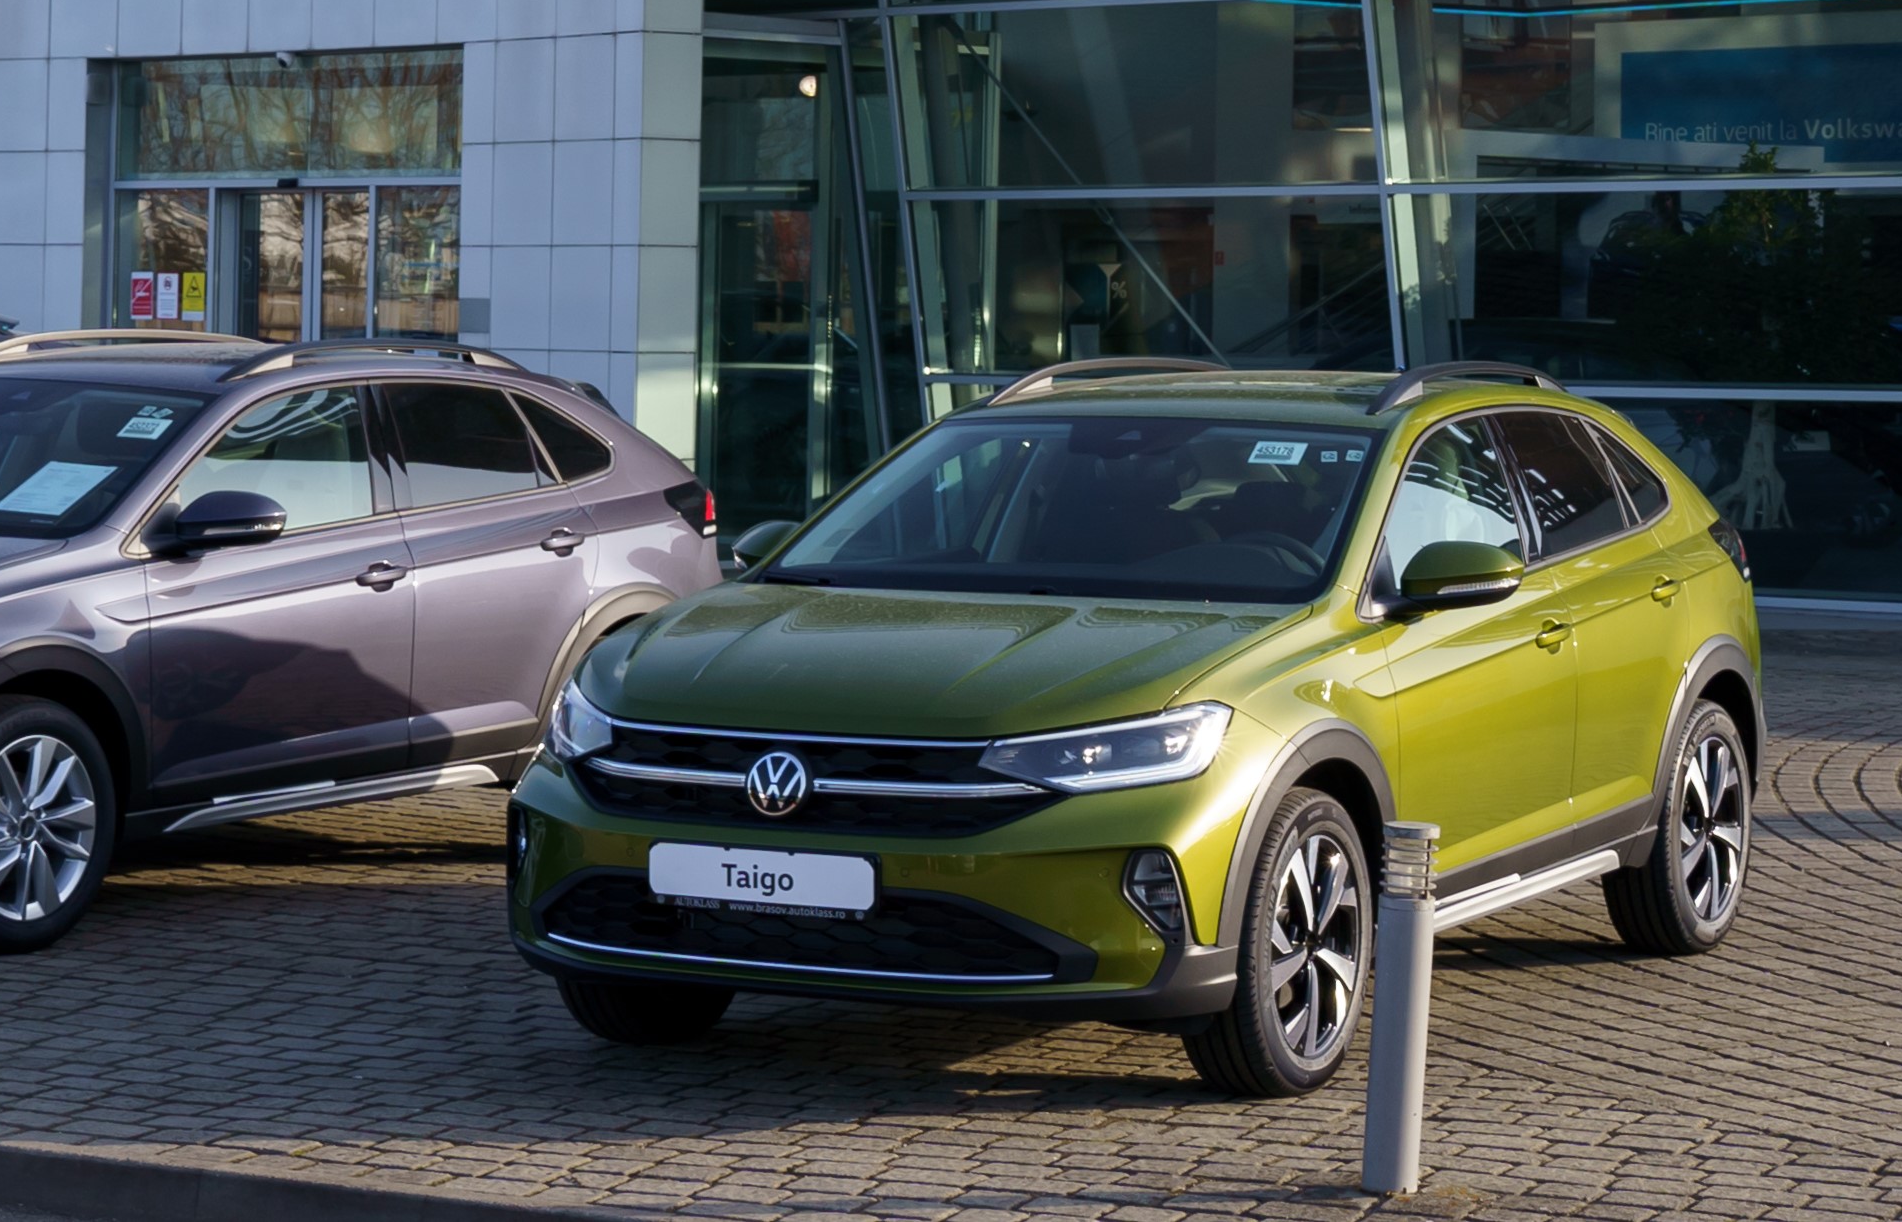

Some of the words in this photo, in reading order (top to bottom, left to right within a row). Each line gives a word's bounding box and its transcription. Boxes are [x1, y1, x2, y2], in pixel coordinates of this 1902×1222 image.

[1722, 120, 1774, 142] venit
[1779, 118, 1798, 141] la
[721, 863, 795, 897] Taigo
[673, 896, 721, 910] AUTOKLASS
[728, 901, 847, 921] www.brasov.autoklass.ro
